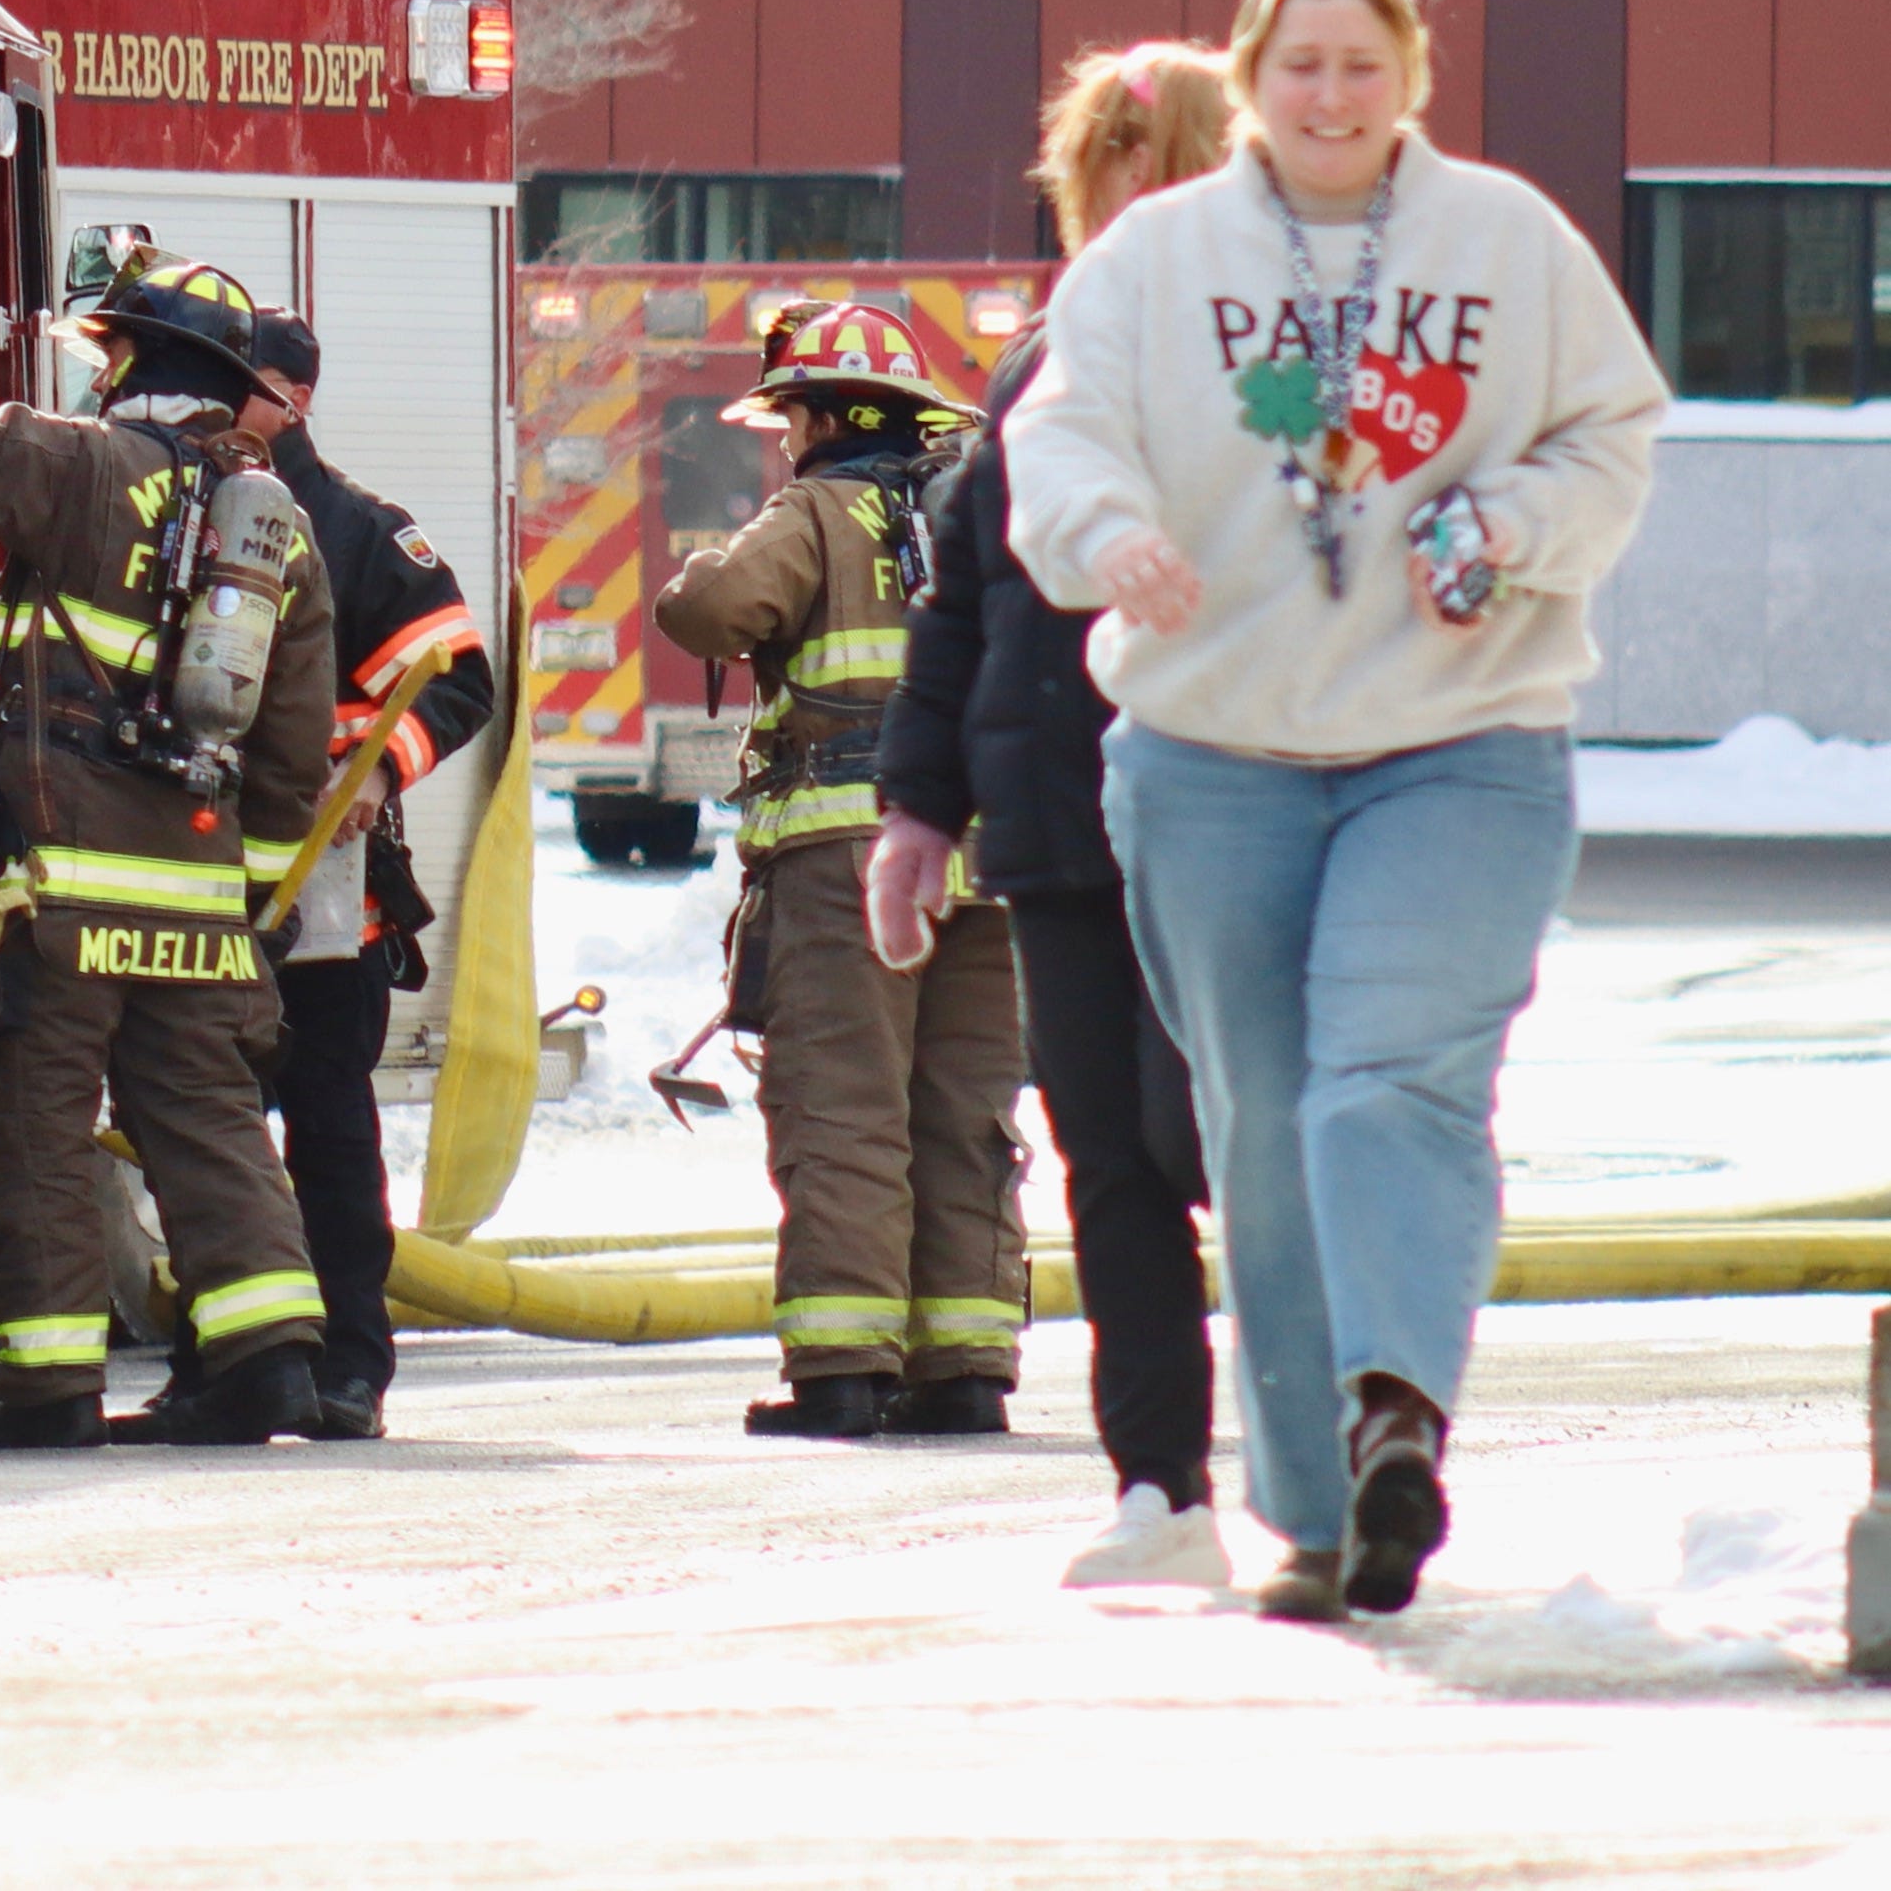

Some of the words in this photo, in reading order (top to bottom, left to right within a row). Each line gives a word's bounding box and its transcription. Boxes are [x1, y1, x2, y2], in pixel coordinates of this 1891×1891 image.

[74, 31, 210, 102] HARBOR
[217, 39, 293, 105] FIRE
[301, 43, 388, 108] DEPT.
[1351, 368, 1442, 453] BOS
[78, 926, 259, 981] MCLELLAN
